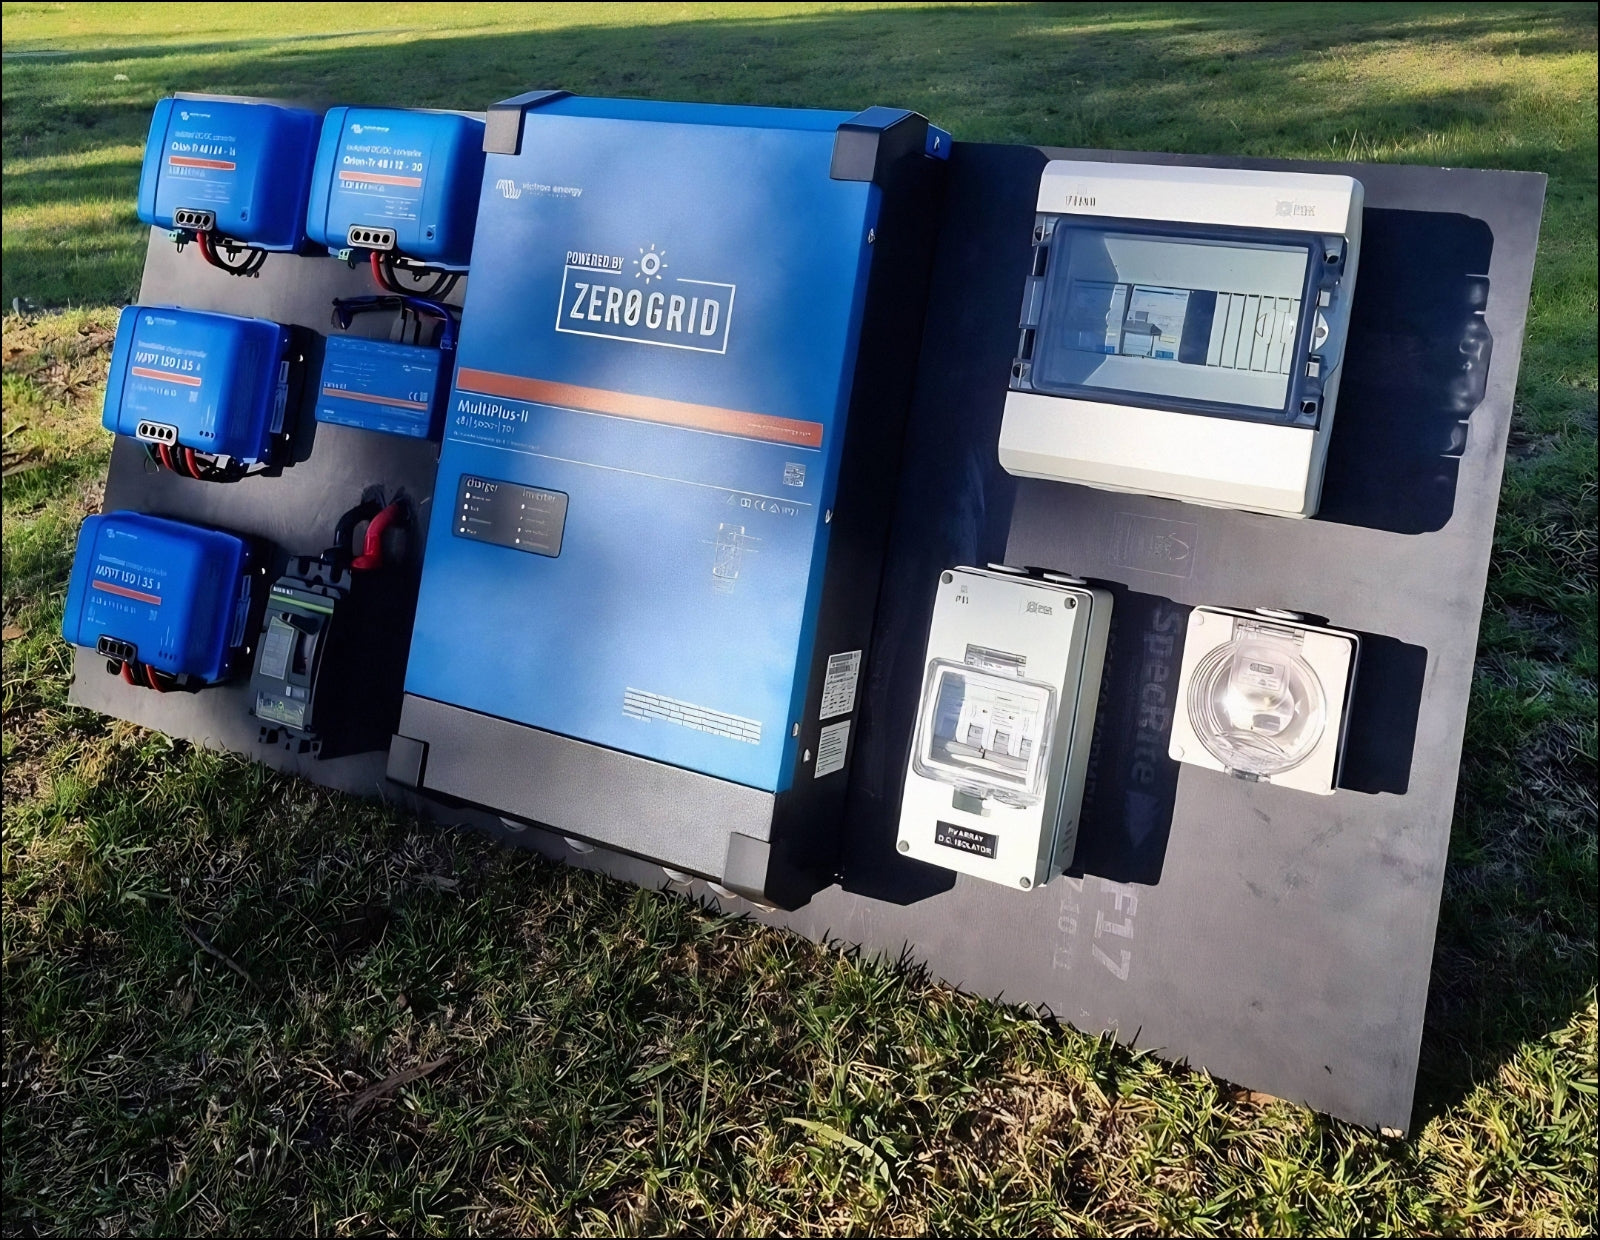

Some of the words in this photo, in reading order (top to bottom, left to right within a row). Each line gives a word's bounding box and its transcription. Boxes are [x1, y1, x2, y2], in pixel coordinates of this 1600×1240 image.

[566, 251, 611, 268] POWERED
[611, 256, 624, 269] BY
[457, 399, 529, 423] MultiPlus-II
[1092, 875, 1139, 981] F17
